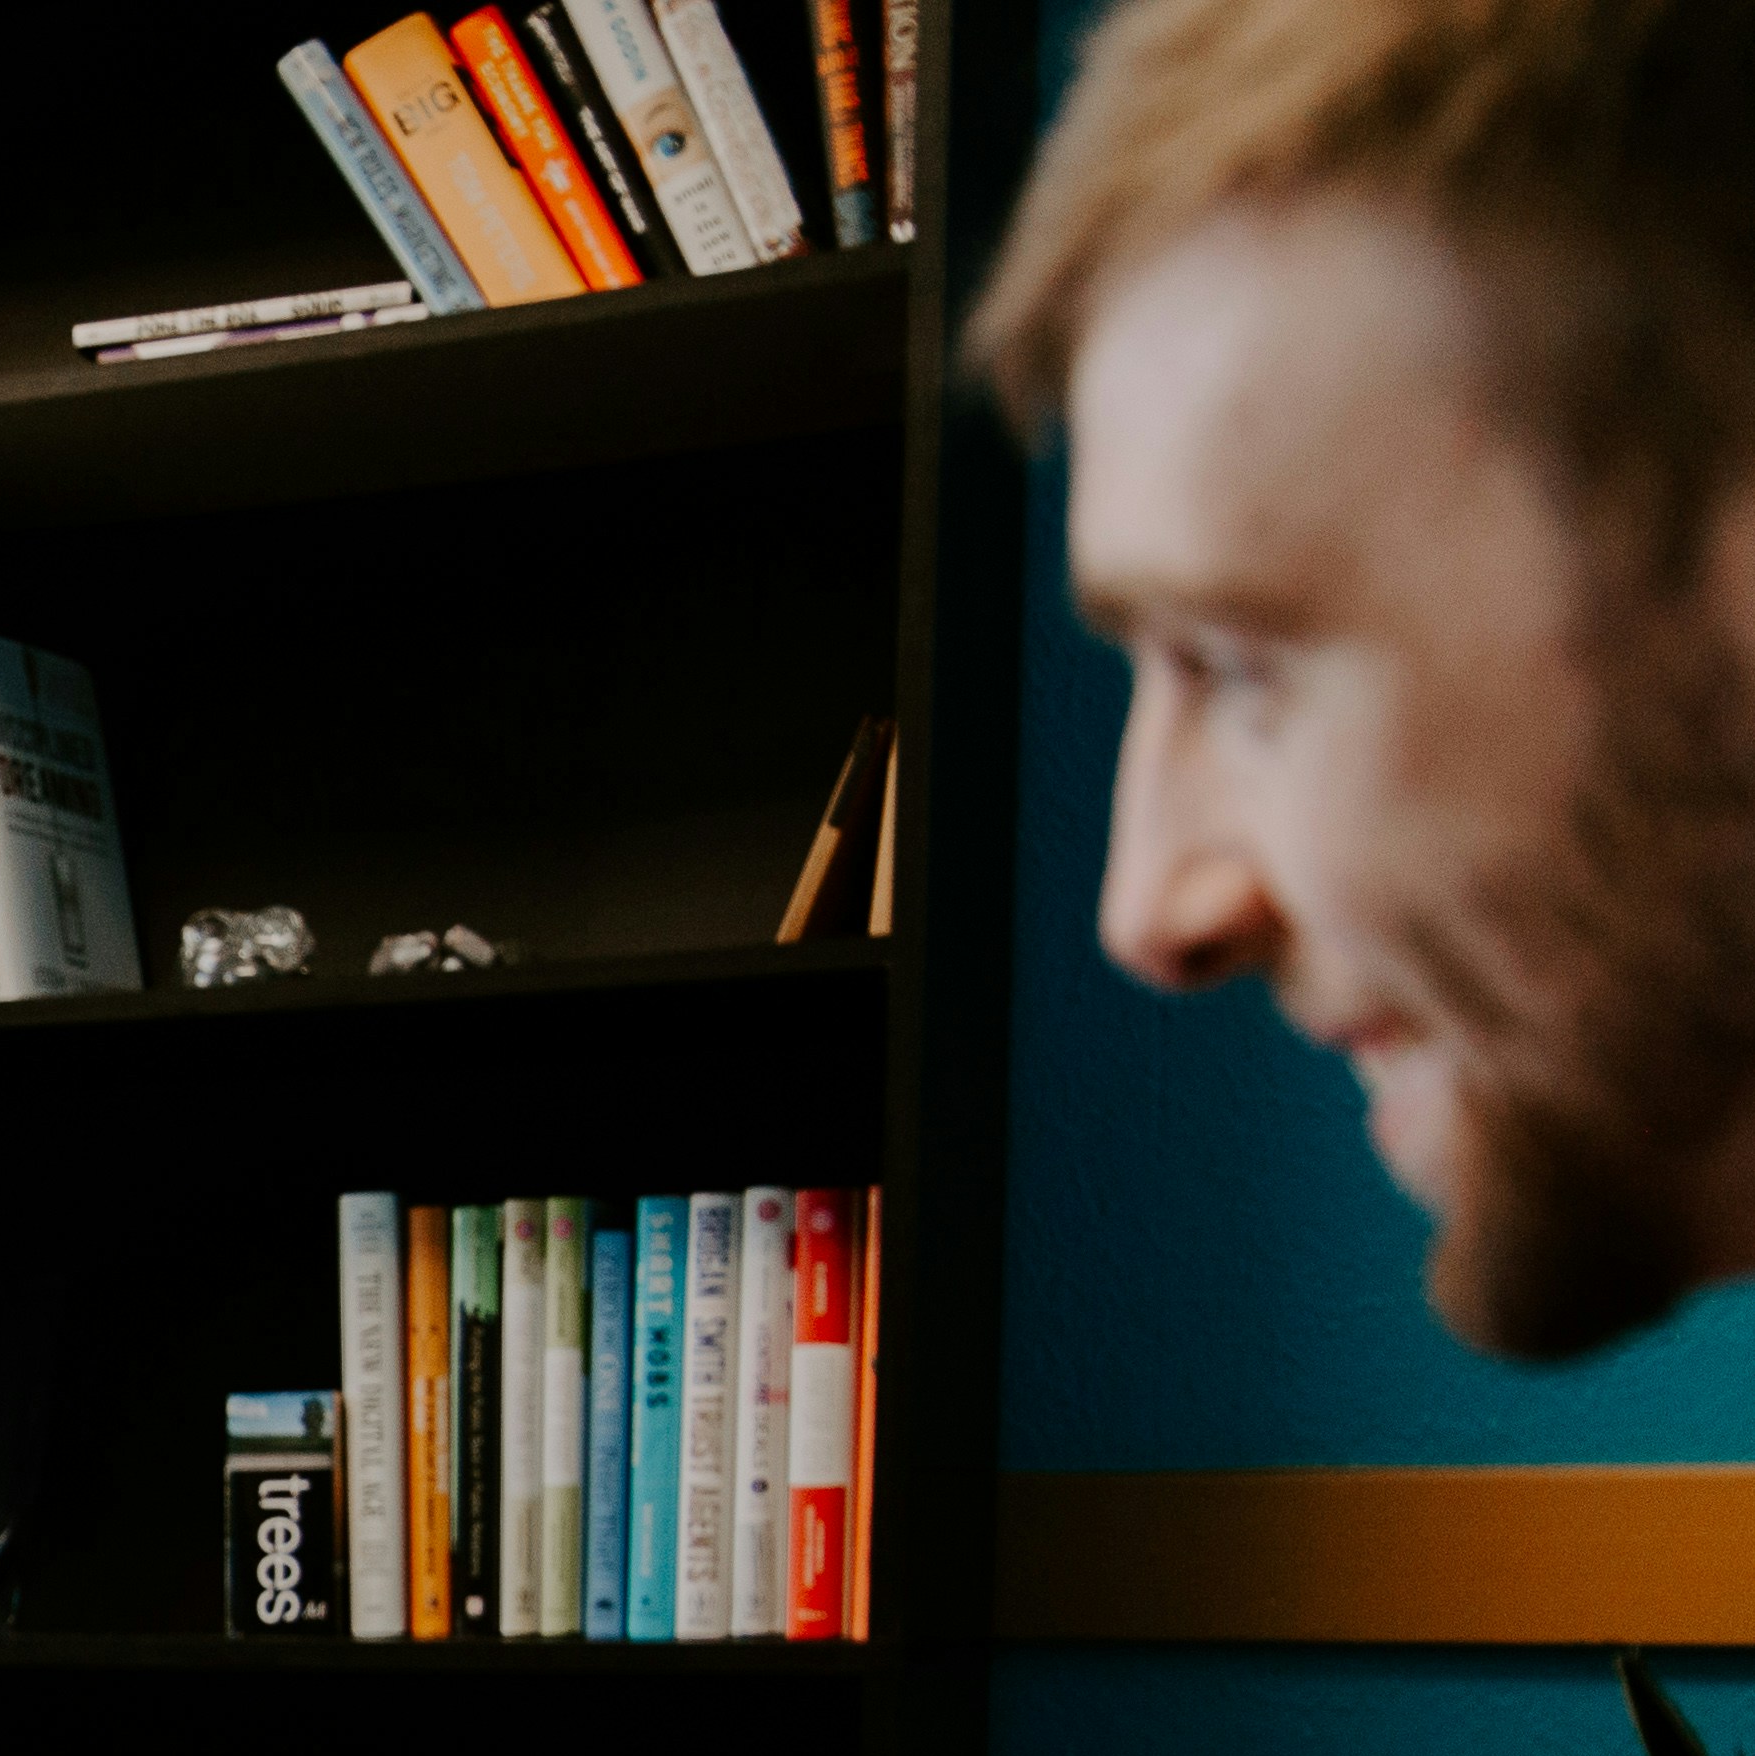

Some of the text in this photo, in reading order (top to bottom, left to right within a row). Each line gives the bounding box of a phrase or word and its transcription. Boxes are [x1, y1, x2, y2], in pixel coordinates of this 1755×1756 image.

[393, 79, 463, 138] BIG
[356, 1271, 380, 1313] THE
[644, 1211, 674, 1410] SMART MOBS
[357, 1323, 382, 1373] NEW
[357, 1383, 384, 1468] DIGITAL
[360, 1480, 383, 1517] AGE
[684, 1391, 723, 1583] TRUST AGENTS
[255, 1473, 310, 1623] trees
